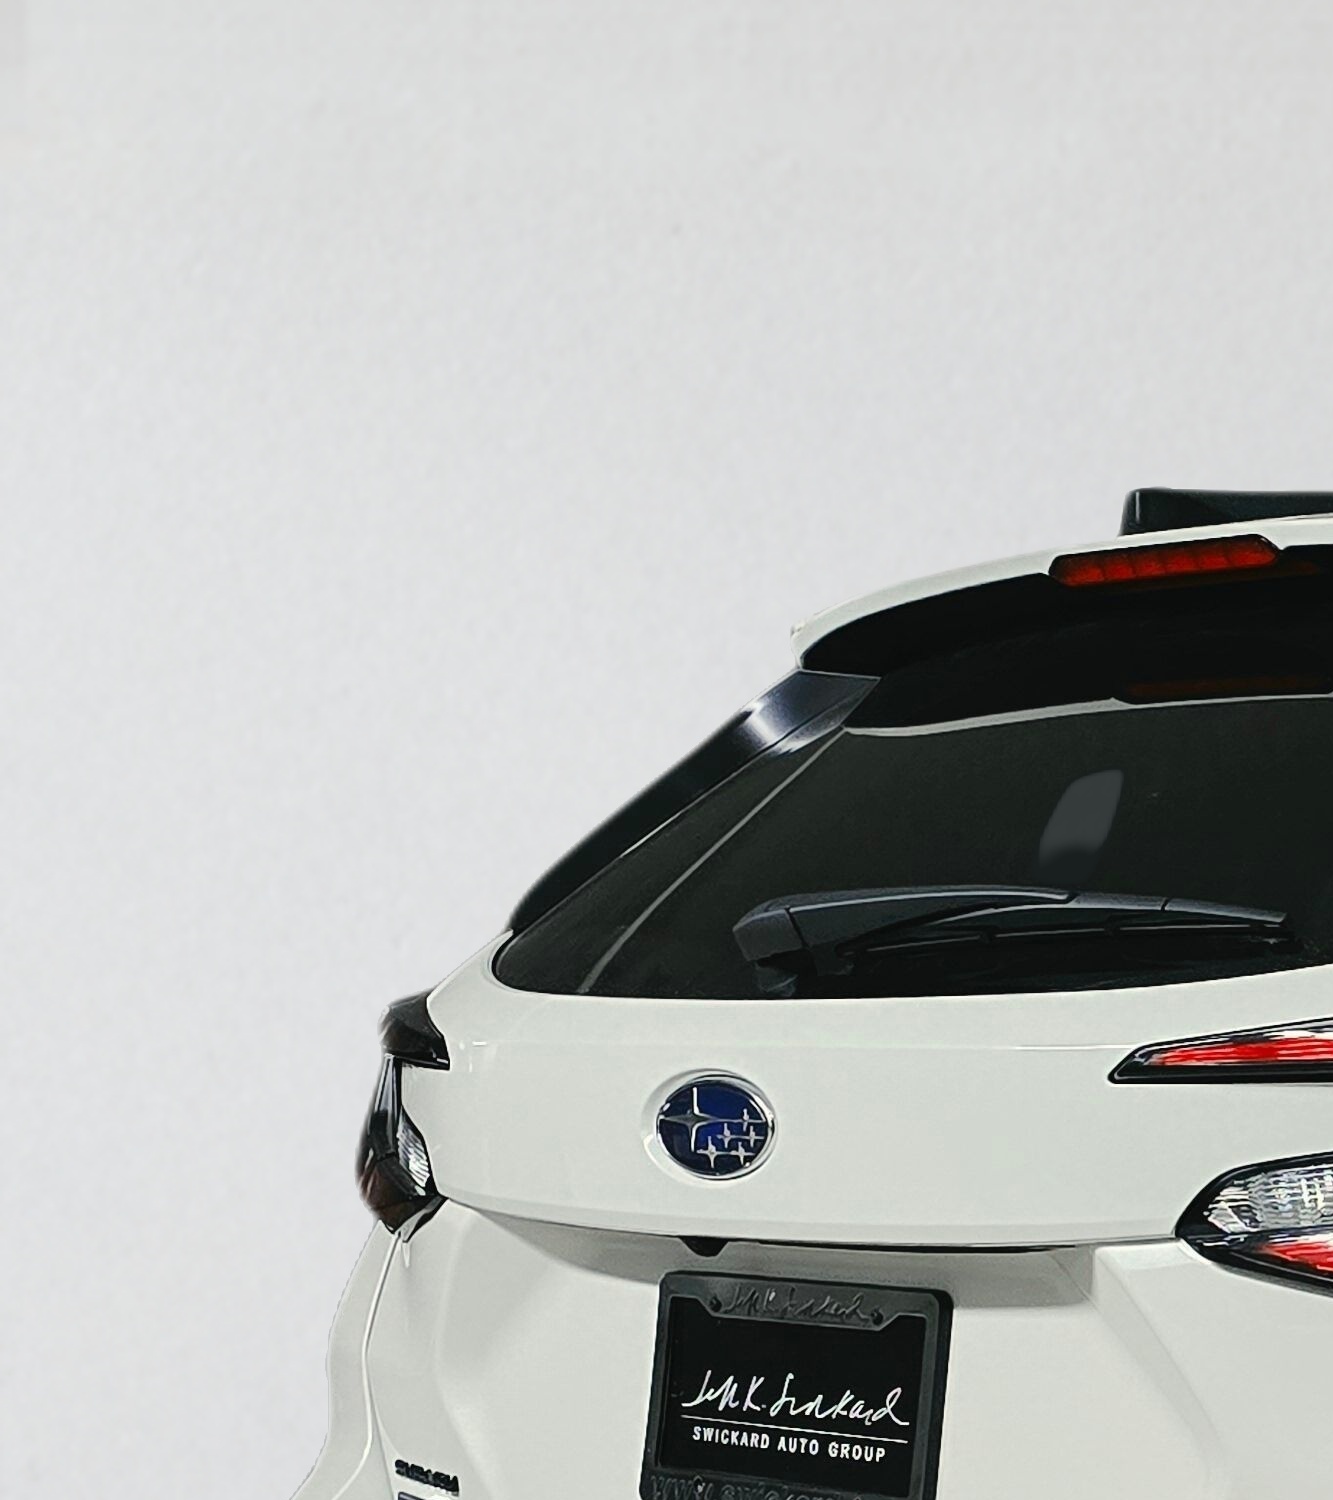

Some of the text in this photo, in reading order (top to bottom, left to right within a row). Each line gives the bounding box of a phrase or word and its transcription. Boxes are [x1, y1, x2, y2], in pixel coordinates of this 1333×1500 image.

[692, 1426, 886, 1463] SWICKARD AUTO GROUP
